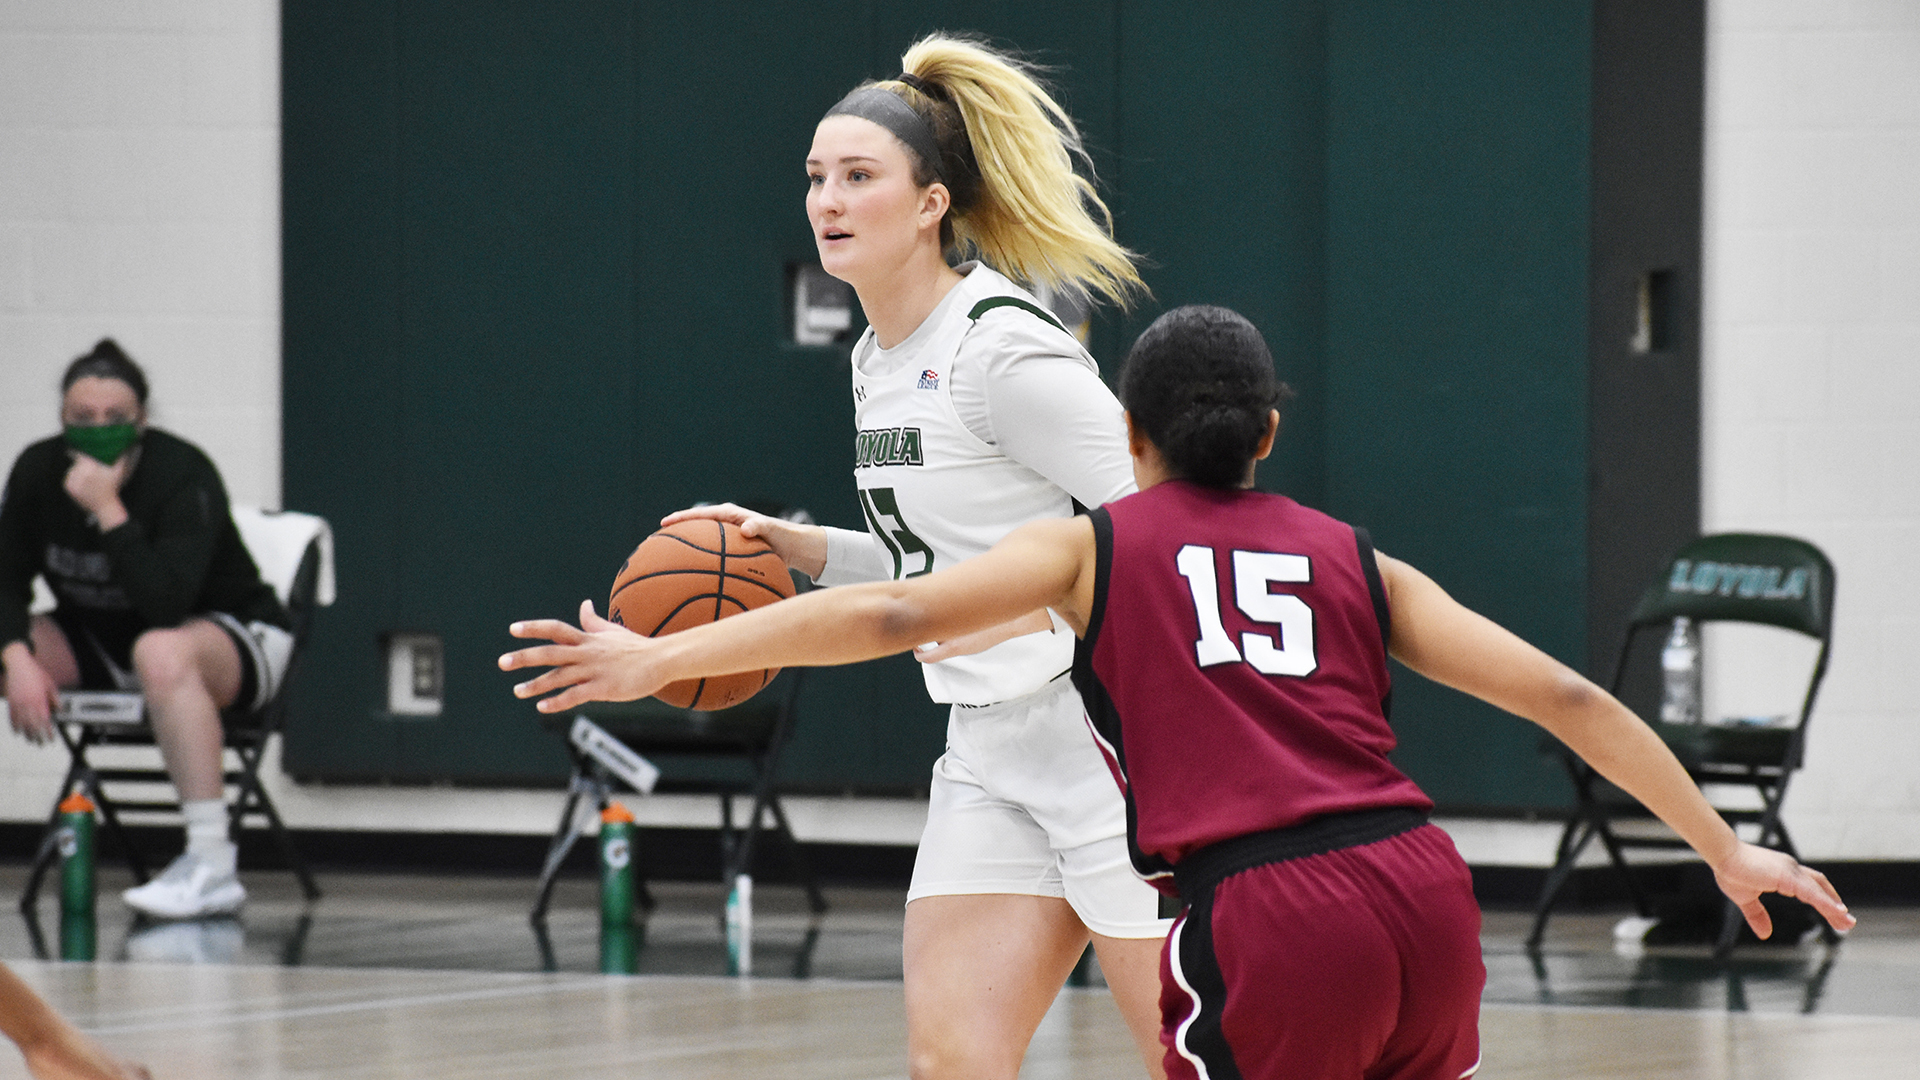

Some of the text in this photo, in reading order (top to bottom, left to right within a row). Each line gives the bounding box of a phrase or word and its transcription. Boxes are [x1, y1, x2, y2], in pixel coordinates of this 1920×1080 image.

[856, 427, 924, 468] OYOLA
[858, 487, 935, 580] 13
[1175, 544, 1320, 679] 15
[1669, 559, 1809, 598] LOYOLA
